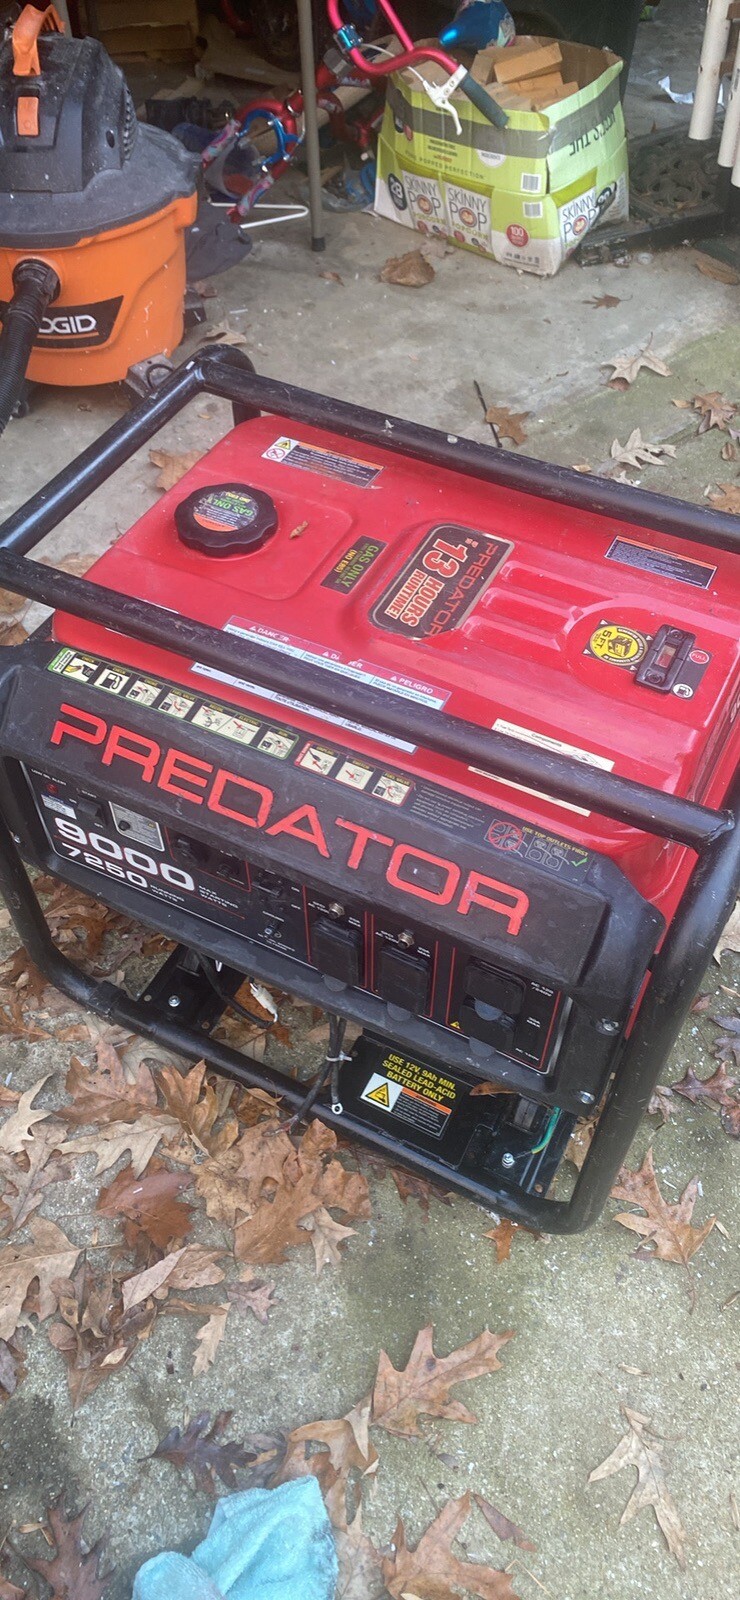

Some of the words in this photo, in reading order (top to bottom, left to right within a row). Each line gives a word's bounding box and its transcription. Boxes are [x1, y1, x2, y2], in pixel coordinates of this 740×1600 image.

[404, 175, 436, 198] SKINNY
[408, 190, 441, 217] POP
[447, 187, 487, 212] SKINNY
[449, 201, 488, 231] POP
[509, 226, 525, 238] 100
[38, 315, 97, 333] DGID
[232, 505, 254, 516] GAS
[358, 544, 380, 566] GAS
[422, 538, 468, 578] 13
[343, 562, 366, 588] ONLY
[384, 568, 427, 620] RUNTIME!
[399, 575, 446, 627] HOURS
[602, 629, 612, 638] 5
[398, 677, 434, 694] PELIGRO
[50, 703, 531, 935] PREDATOR
[55, 817, 195, 891] 9000
[522, 826, 533, 836] USE
[534, 831, 546, 841] TOP
[546, 836, 571, 851] OUTLETS
[572, 846, 589, 857] FIRST
[61, 842, 149, 889] 7250
[150, 884, 185, 903] RUNNING
[152, 889, 178, 903] WATTS
[199, 885, 217, 896] MAX
[200, 890, 239, 909] STARTING
[201, 894, 228, 908] WATTS
[382, 1059, 413, 1079] SEALED
[413, 1073, 456, 1100] LEAD-ACID
[388, 1053, 405, 1067] USE
[406, 1060, 421, 1074] 12V,
[422, 1069, 438, 1083] 9Ah
[438, 1076, 456, 1091] MIN.
[386, 1071, 422, 1093] BATTERY
[422, 1086, 444, 1102] ONLY
